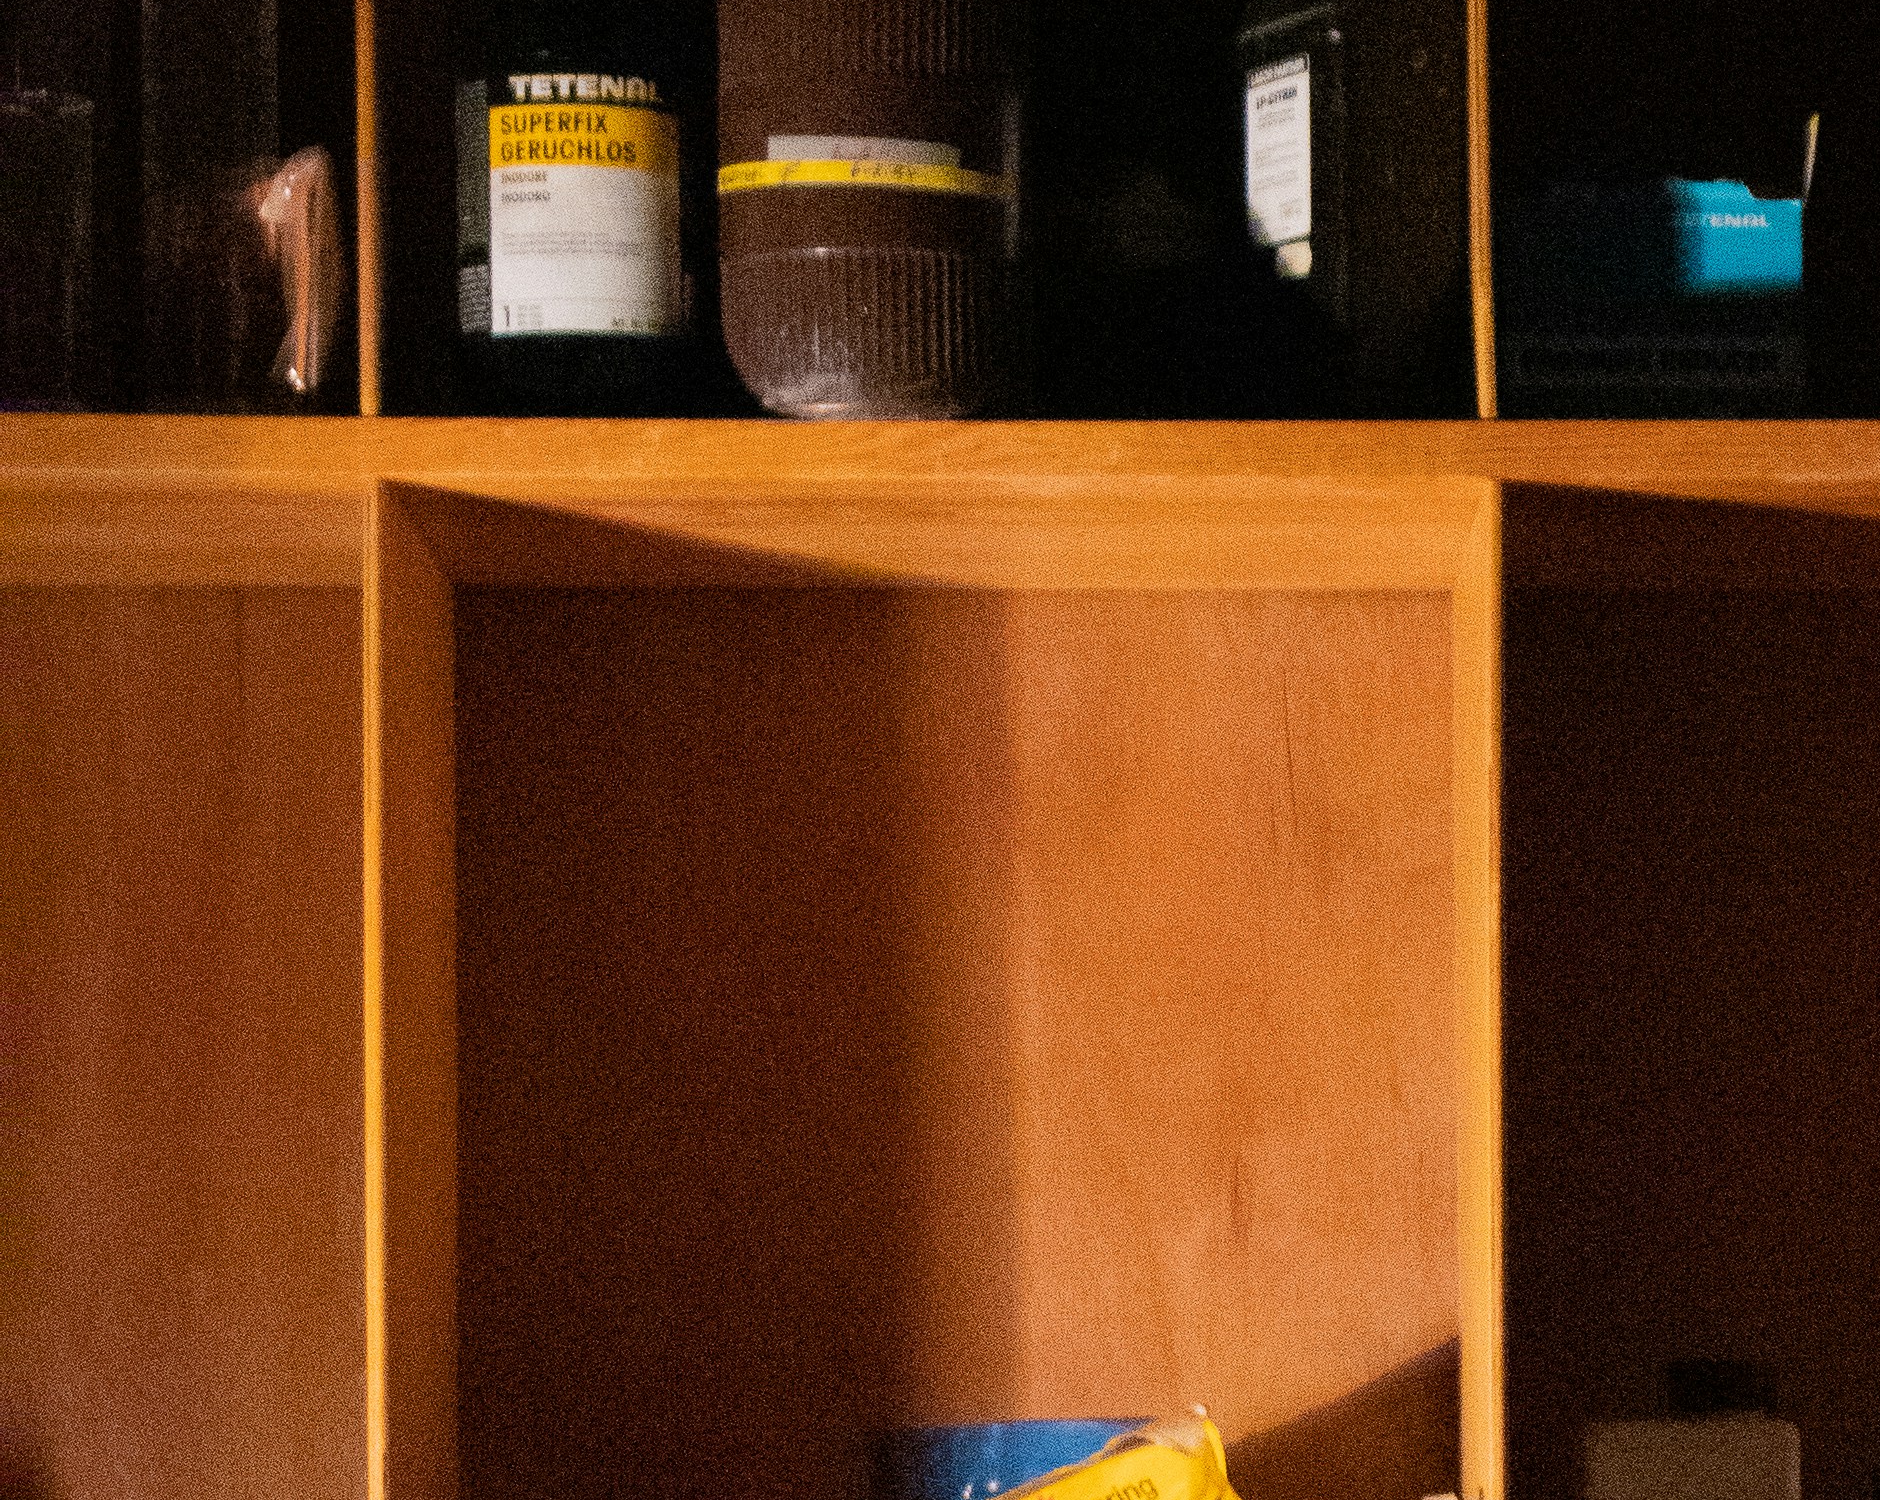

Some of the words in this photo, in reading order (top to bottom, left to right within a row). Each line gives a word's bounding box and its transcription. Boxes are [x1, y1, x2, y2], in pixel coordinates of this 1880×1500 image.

[508, 73, 662, 102] TETENAL
[500, 112, 607, 135] SUPERFIX
[500, 138, 637, 163] GERUCHLOS
